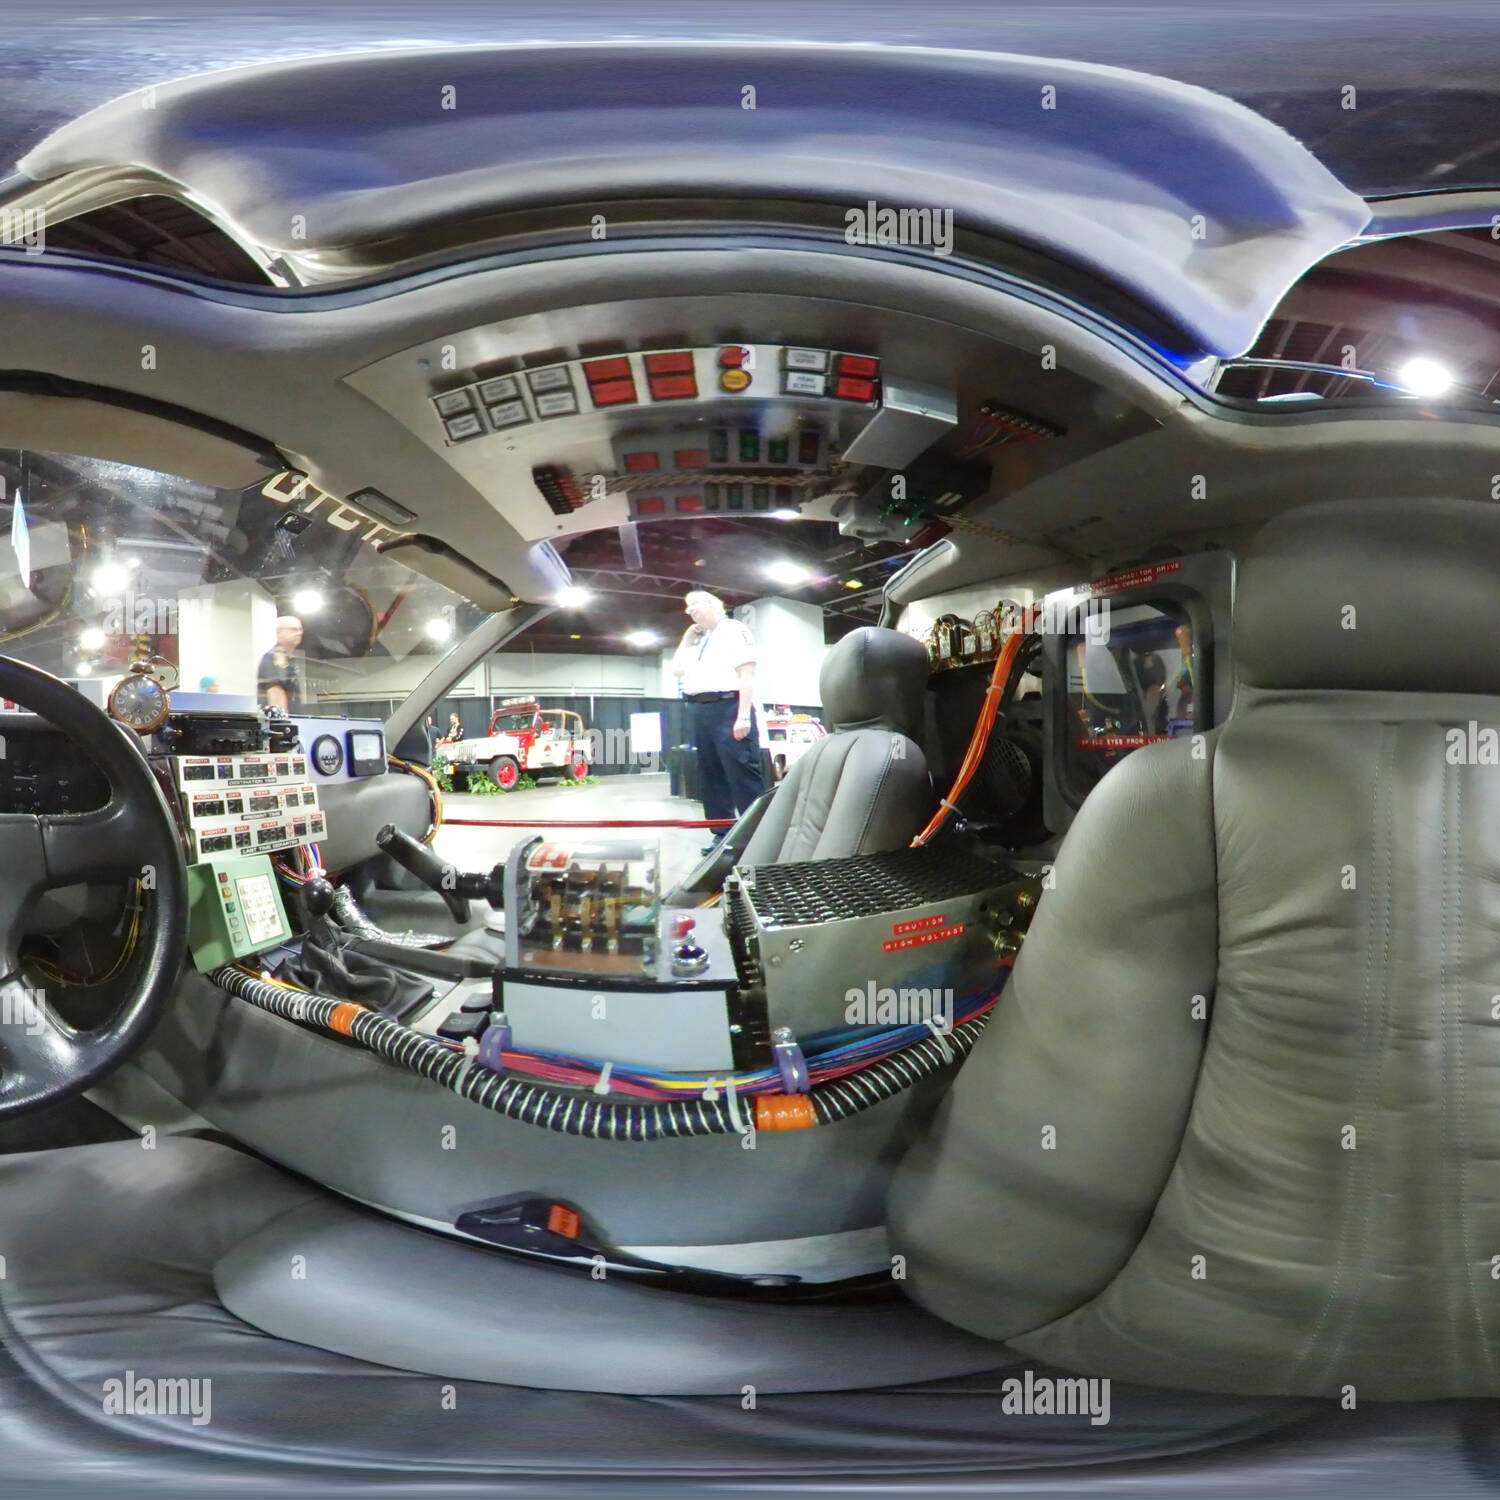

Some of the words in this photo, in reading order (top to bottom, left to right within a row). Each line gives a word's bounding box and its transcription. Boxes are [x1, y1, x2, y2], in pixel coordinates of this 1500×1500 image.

[1106, 737, 1123, 746] EYES
[896, 916, 944, 934] CAUTION
[884, 939, 913, 951] HIGH
[920, 926, 965, 943] VOLTAGE
